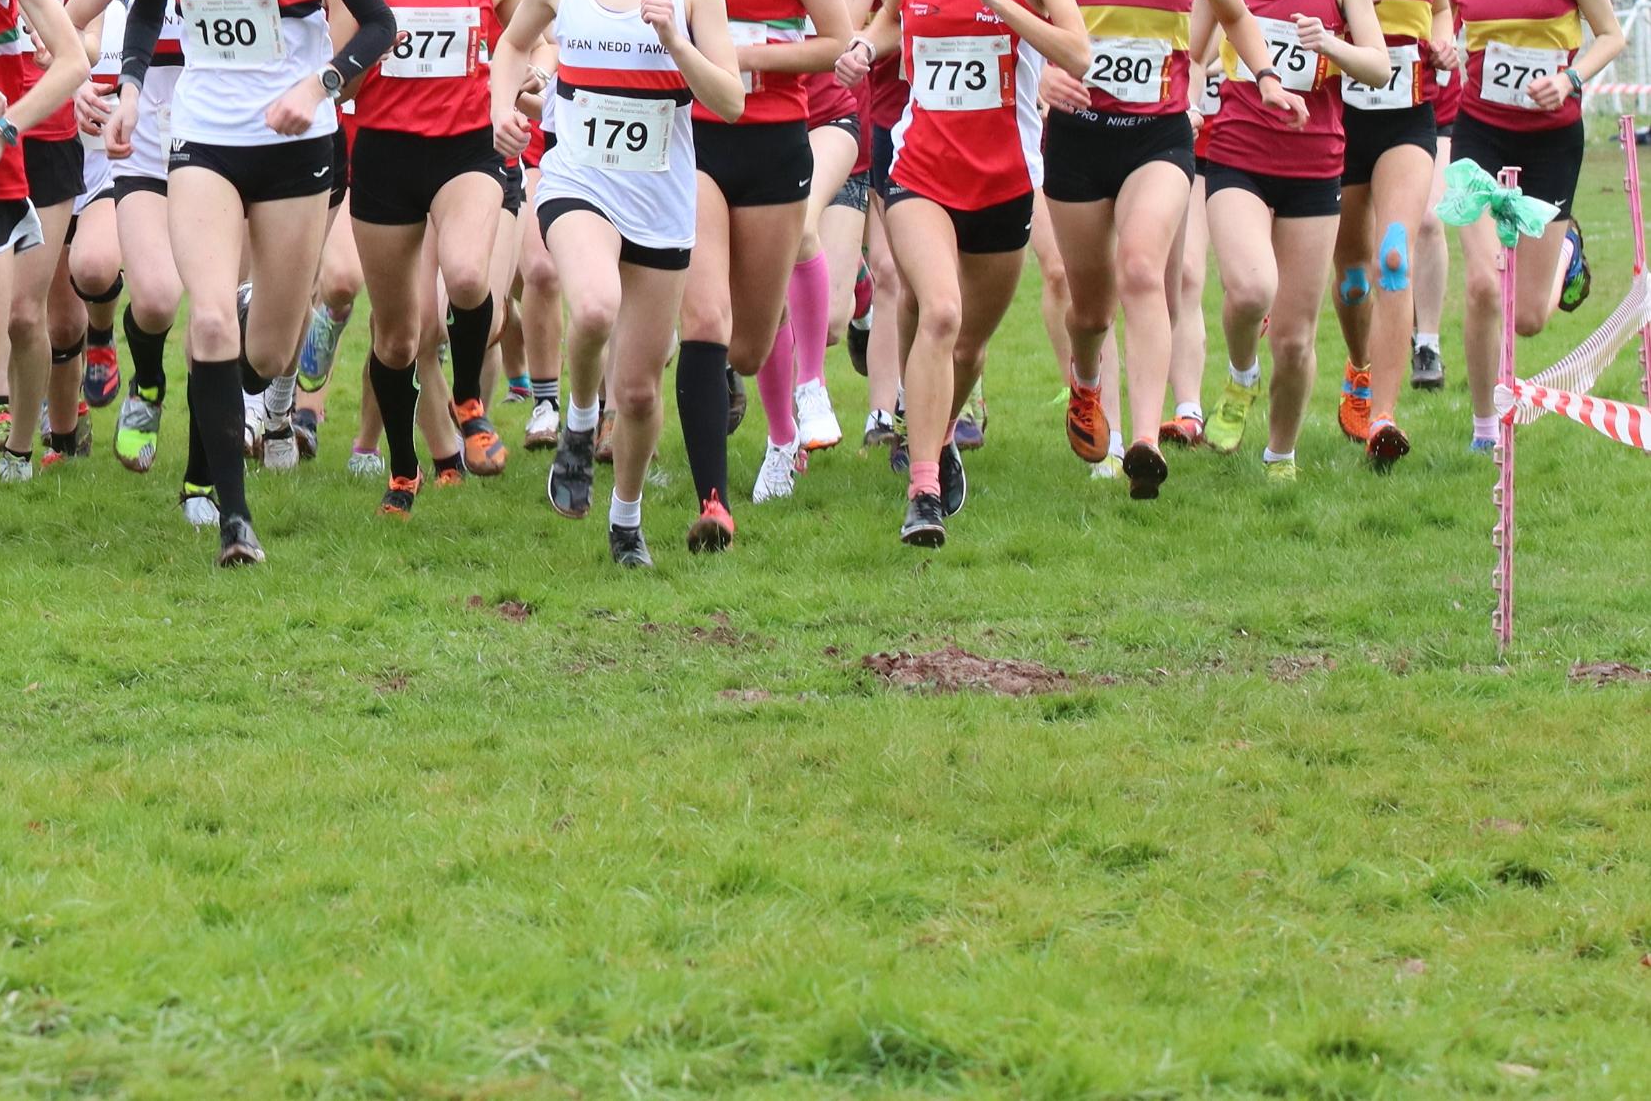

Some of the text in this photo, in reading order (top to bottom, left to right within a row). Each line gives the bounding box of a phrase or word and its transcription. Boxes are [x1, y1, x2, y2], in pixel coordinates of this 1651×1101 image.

[195, 18, 257, 46] 180
[393, 30, 456, 60] 877
[567, 39, 592, 50] AFAN
[598, 41, 631, 53] NEDD
[100, 51, 124, 60] AWE
[1091, 54, 1153, 84] 280
[1265, 39, 1306, 72] 75
[925, 60, 987, 91] 773
[583, 117, 648, 152] 179
[1106, 115, 1136, 127] NIKE
